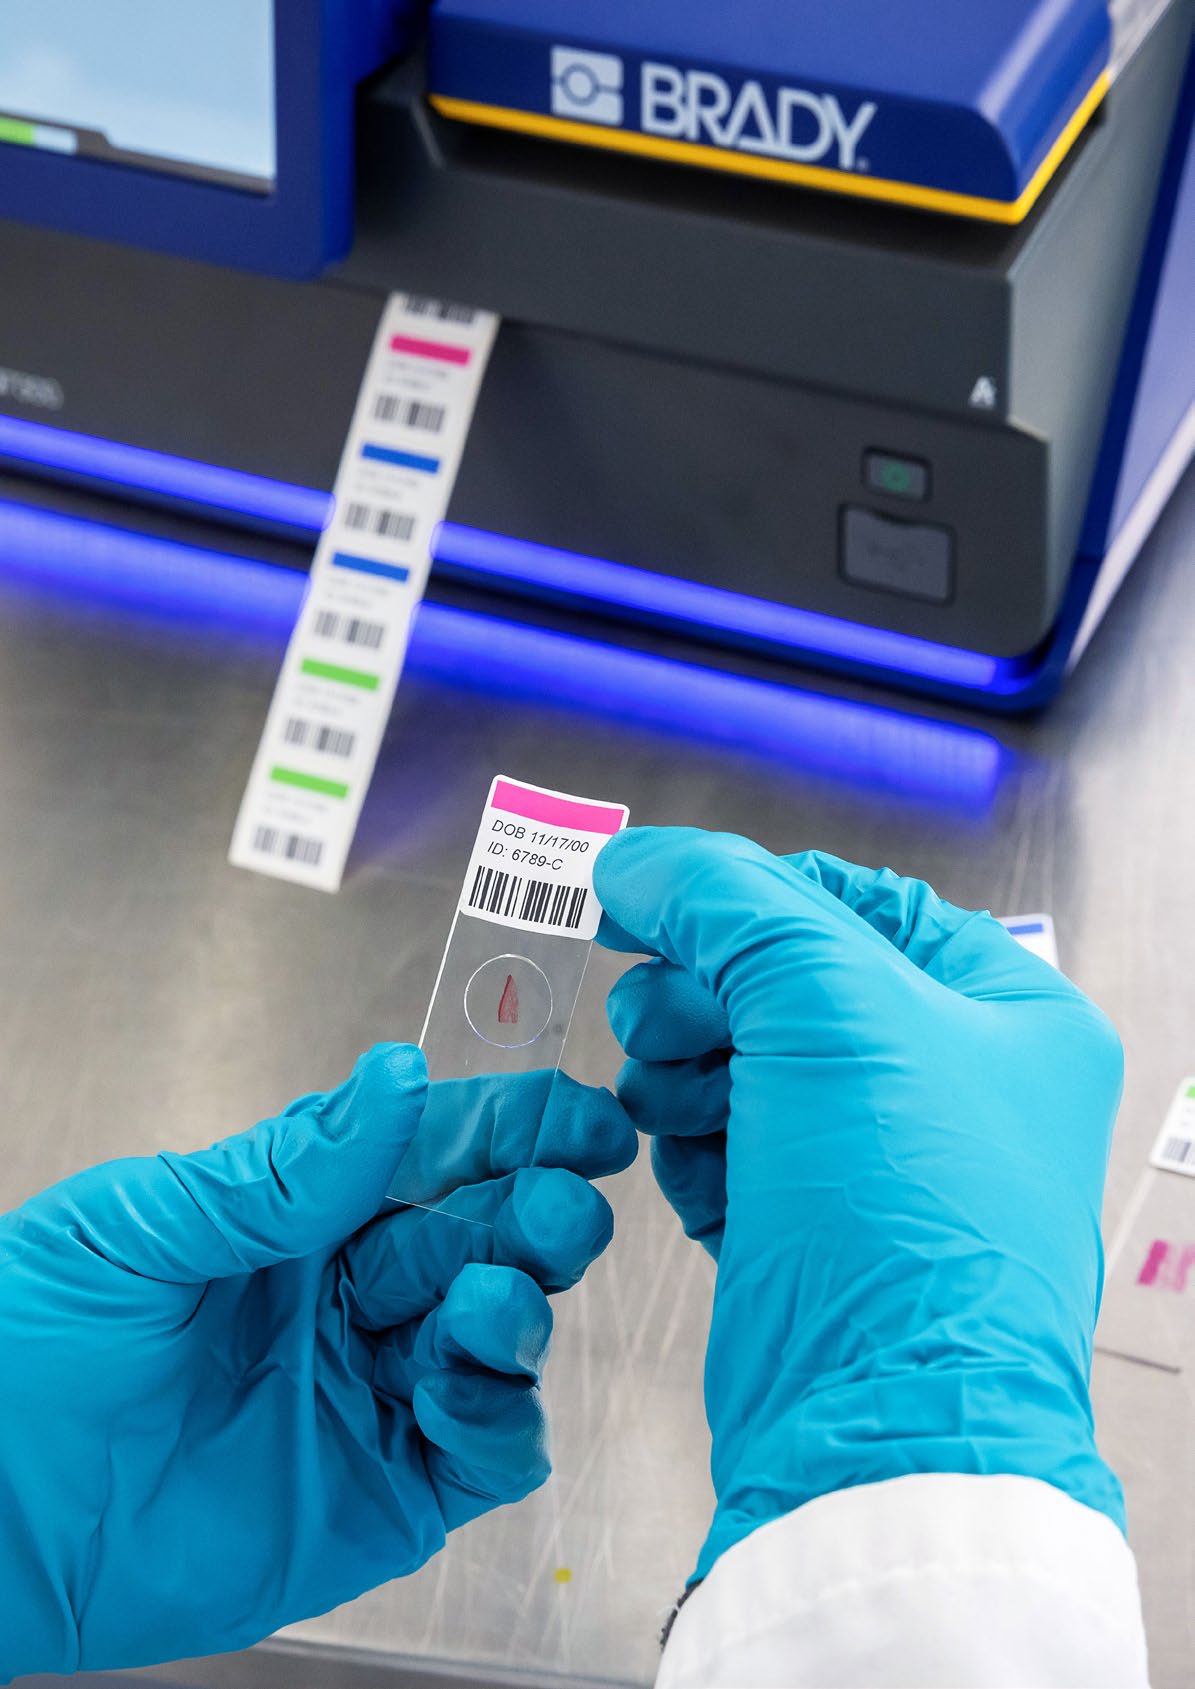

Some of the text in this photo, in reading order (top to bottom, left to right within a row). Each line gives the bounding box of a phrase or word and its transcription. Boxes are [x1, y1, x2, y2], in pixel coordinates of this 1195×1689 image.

[641, 62, 877, 170] BRADY
[492, 819, 589, 853] DOB 11/17/00
[487, 841, 563, 871] ID: 6789-C
